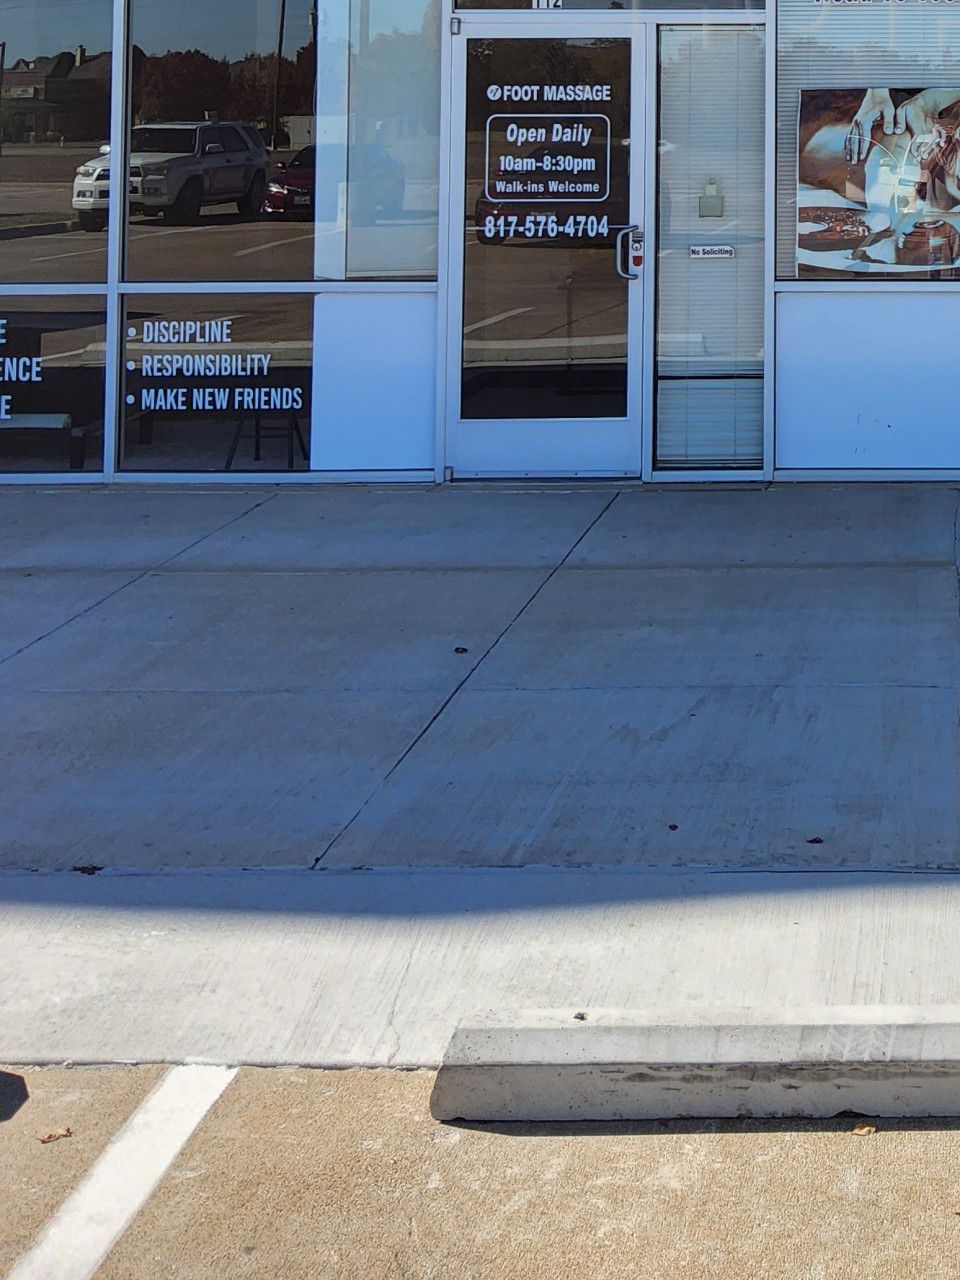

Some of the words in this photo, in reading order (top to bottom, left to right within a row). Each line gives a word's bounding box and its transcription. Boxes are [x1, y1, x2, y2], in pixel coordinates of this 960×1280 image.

[503, 85, 540, 101] FOOT
[543, 85, 612, 101] MASSAGE
[506, 123, 547, 146] Open
[552, 123, 593, 146] Daily
[499, 155, 595, 174] 10am-8:30pm
[495, 181, 545, 193] Walk-ins
[548, 180, 601, 193] Welcome
[484, 215, 609, 238] 817-576-4704
[702, 248, 733, 257] Soliciting
[142, 321, 233, 343] DISCIPLINE
[0, 357, 42, 381] NCE
[141, 354, 272, 377] RESPONSIBILITY
[141, 388, 187, 410] MAKE
[192, 388, 229, 410] NEW
[234, 387, 303, 410] FRIENDS
